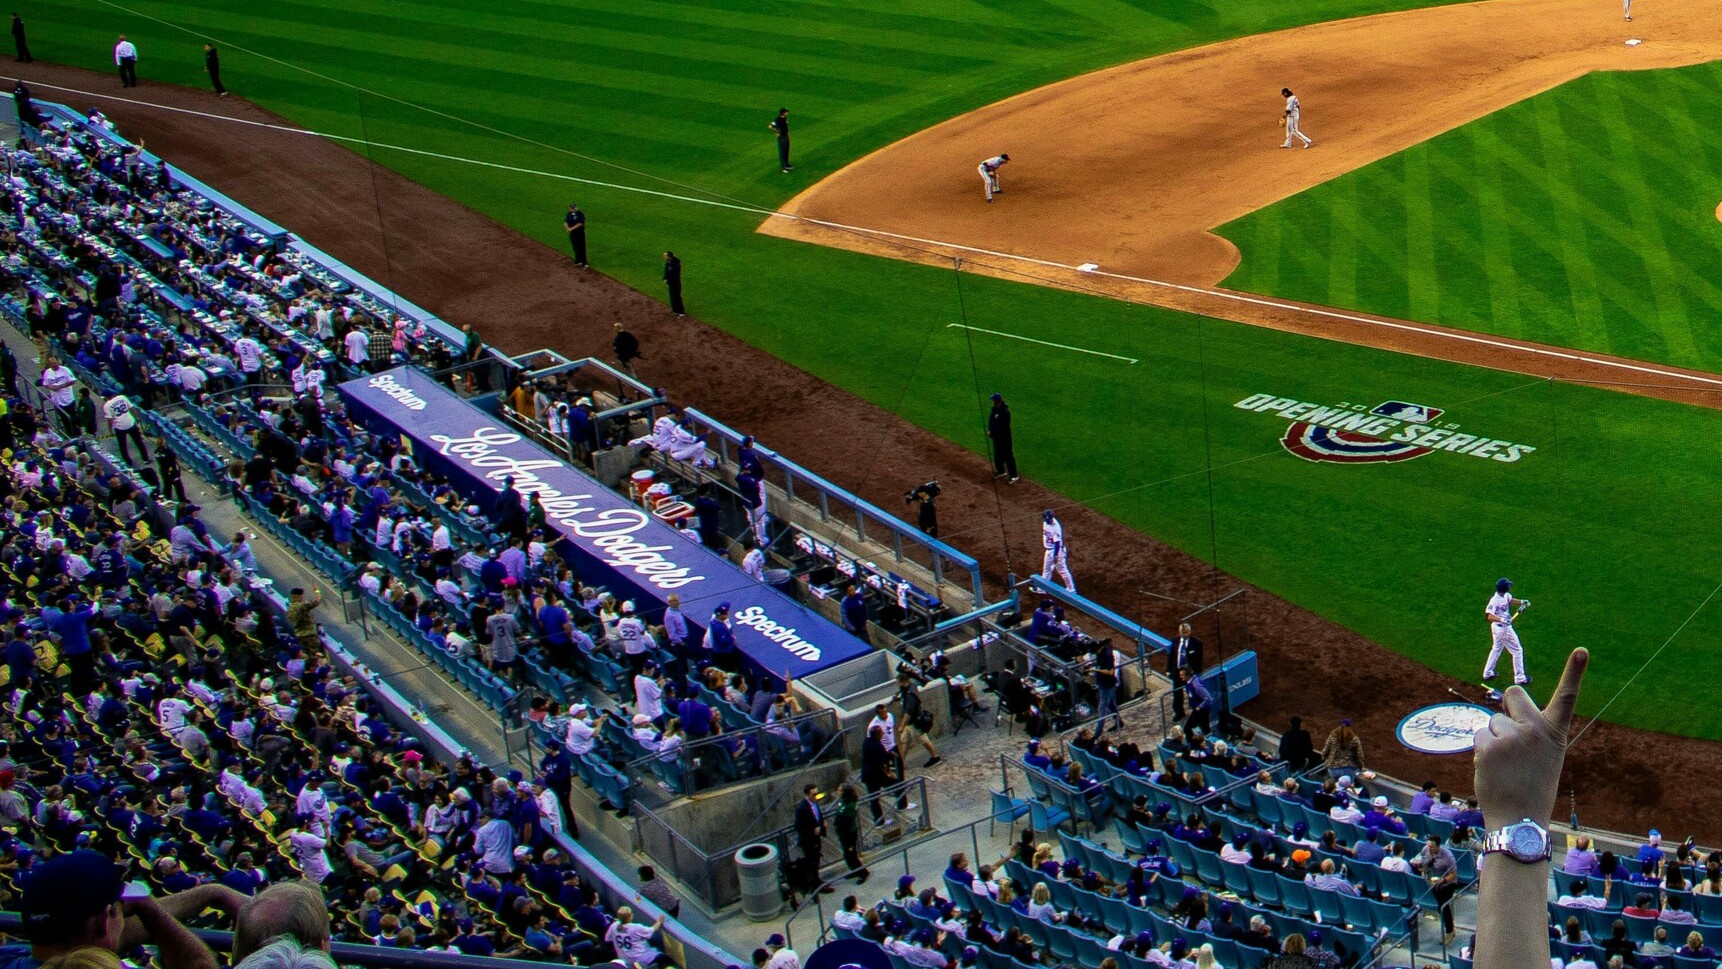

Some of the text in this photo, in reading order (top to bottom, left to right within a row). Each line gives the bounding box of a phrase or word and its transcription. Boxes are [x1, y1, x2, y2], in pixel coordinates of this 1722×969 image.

[369, 374, 427, 411] Spectrum
[1233, 393, 1537, 463] OPENING SERIES
[560, 508, 705, 589] Dodgers
[735, 606, 821, 662] Spectrum
